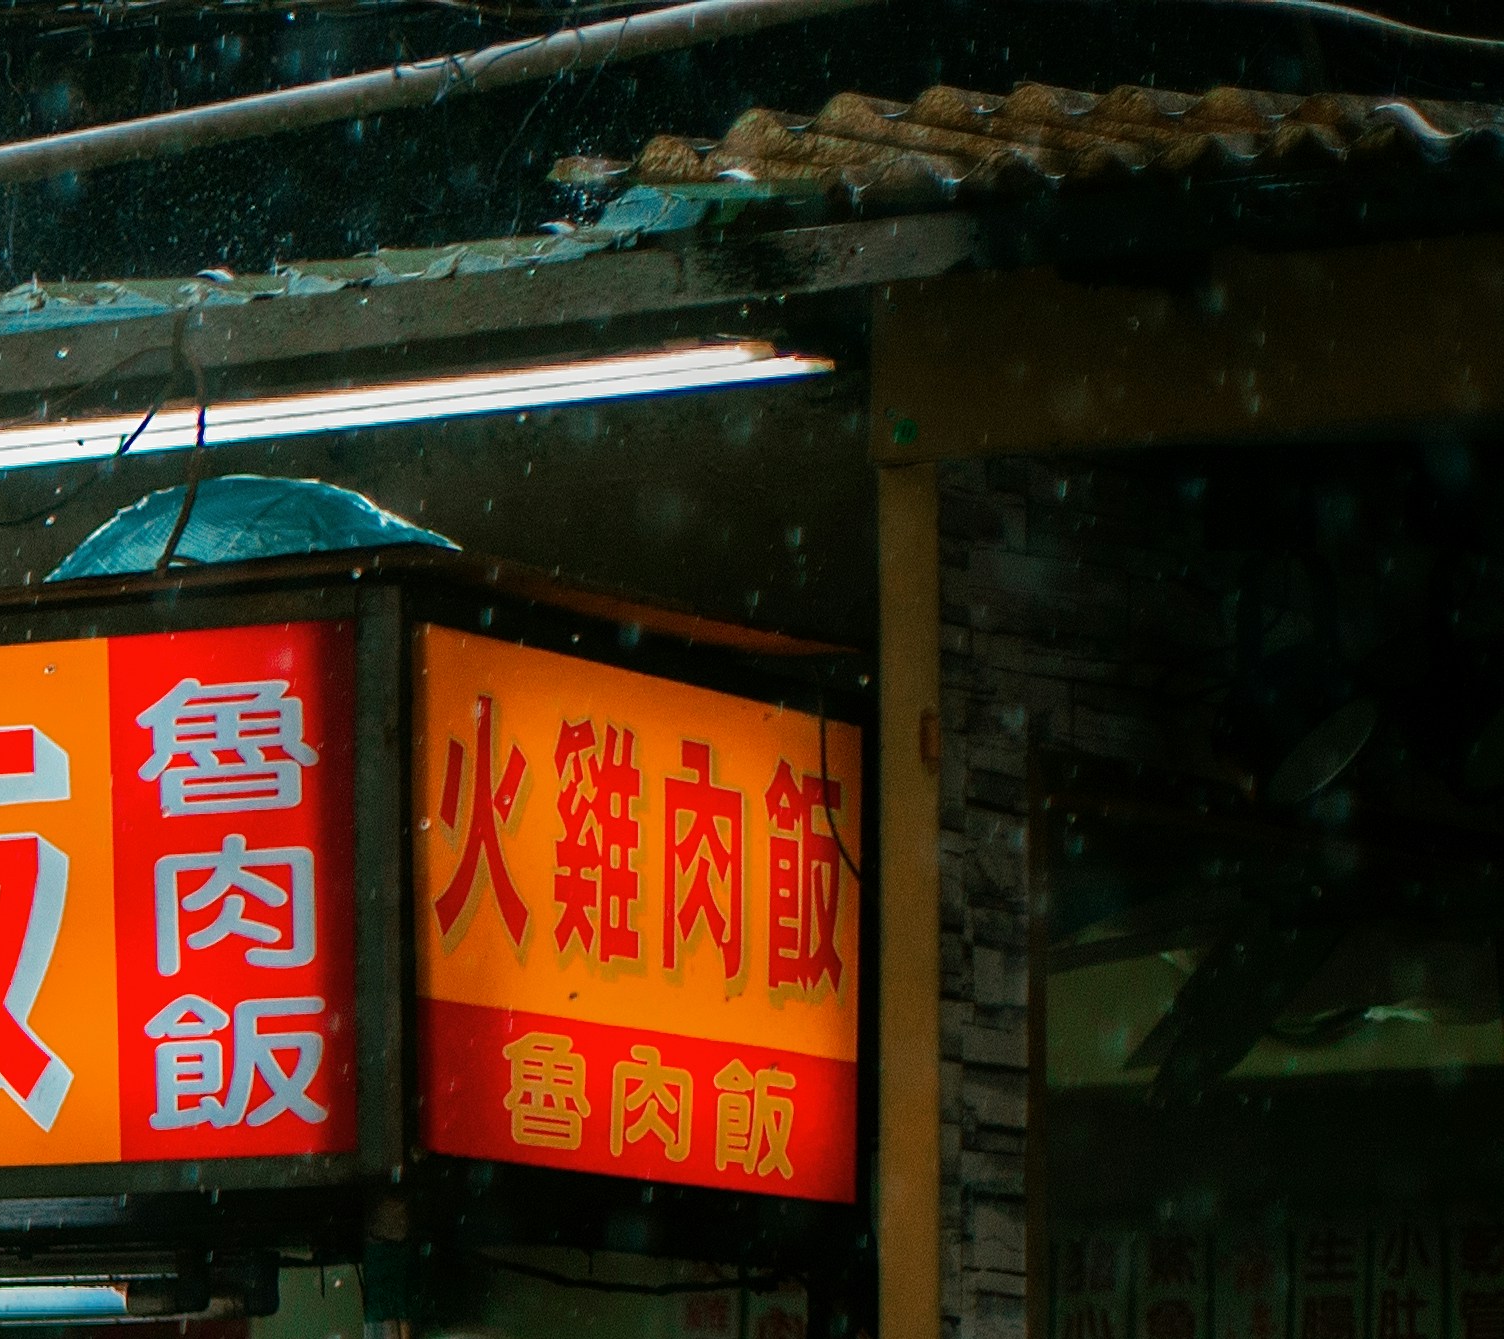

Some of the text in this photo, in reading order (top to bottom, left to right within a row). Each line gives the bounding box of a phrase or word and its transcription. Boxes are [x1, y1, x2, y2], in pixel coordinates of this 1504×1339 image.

[135, 677, 330, 1130] 魯肉飯
[432, 694, 845, 1001] 火雞肉飯
[502, 1031, 796, 1180] 魯肉飯
